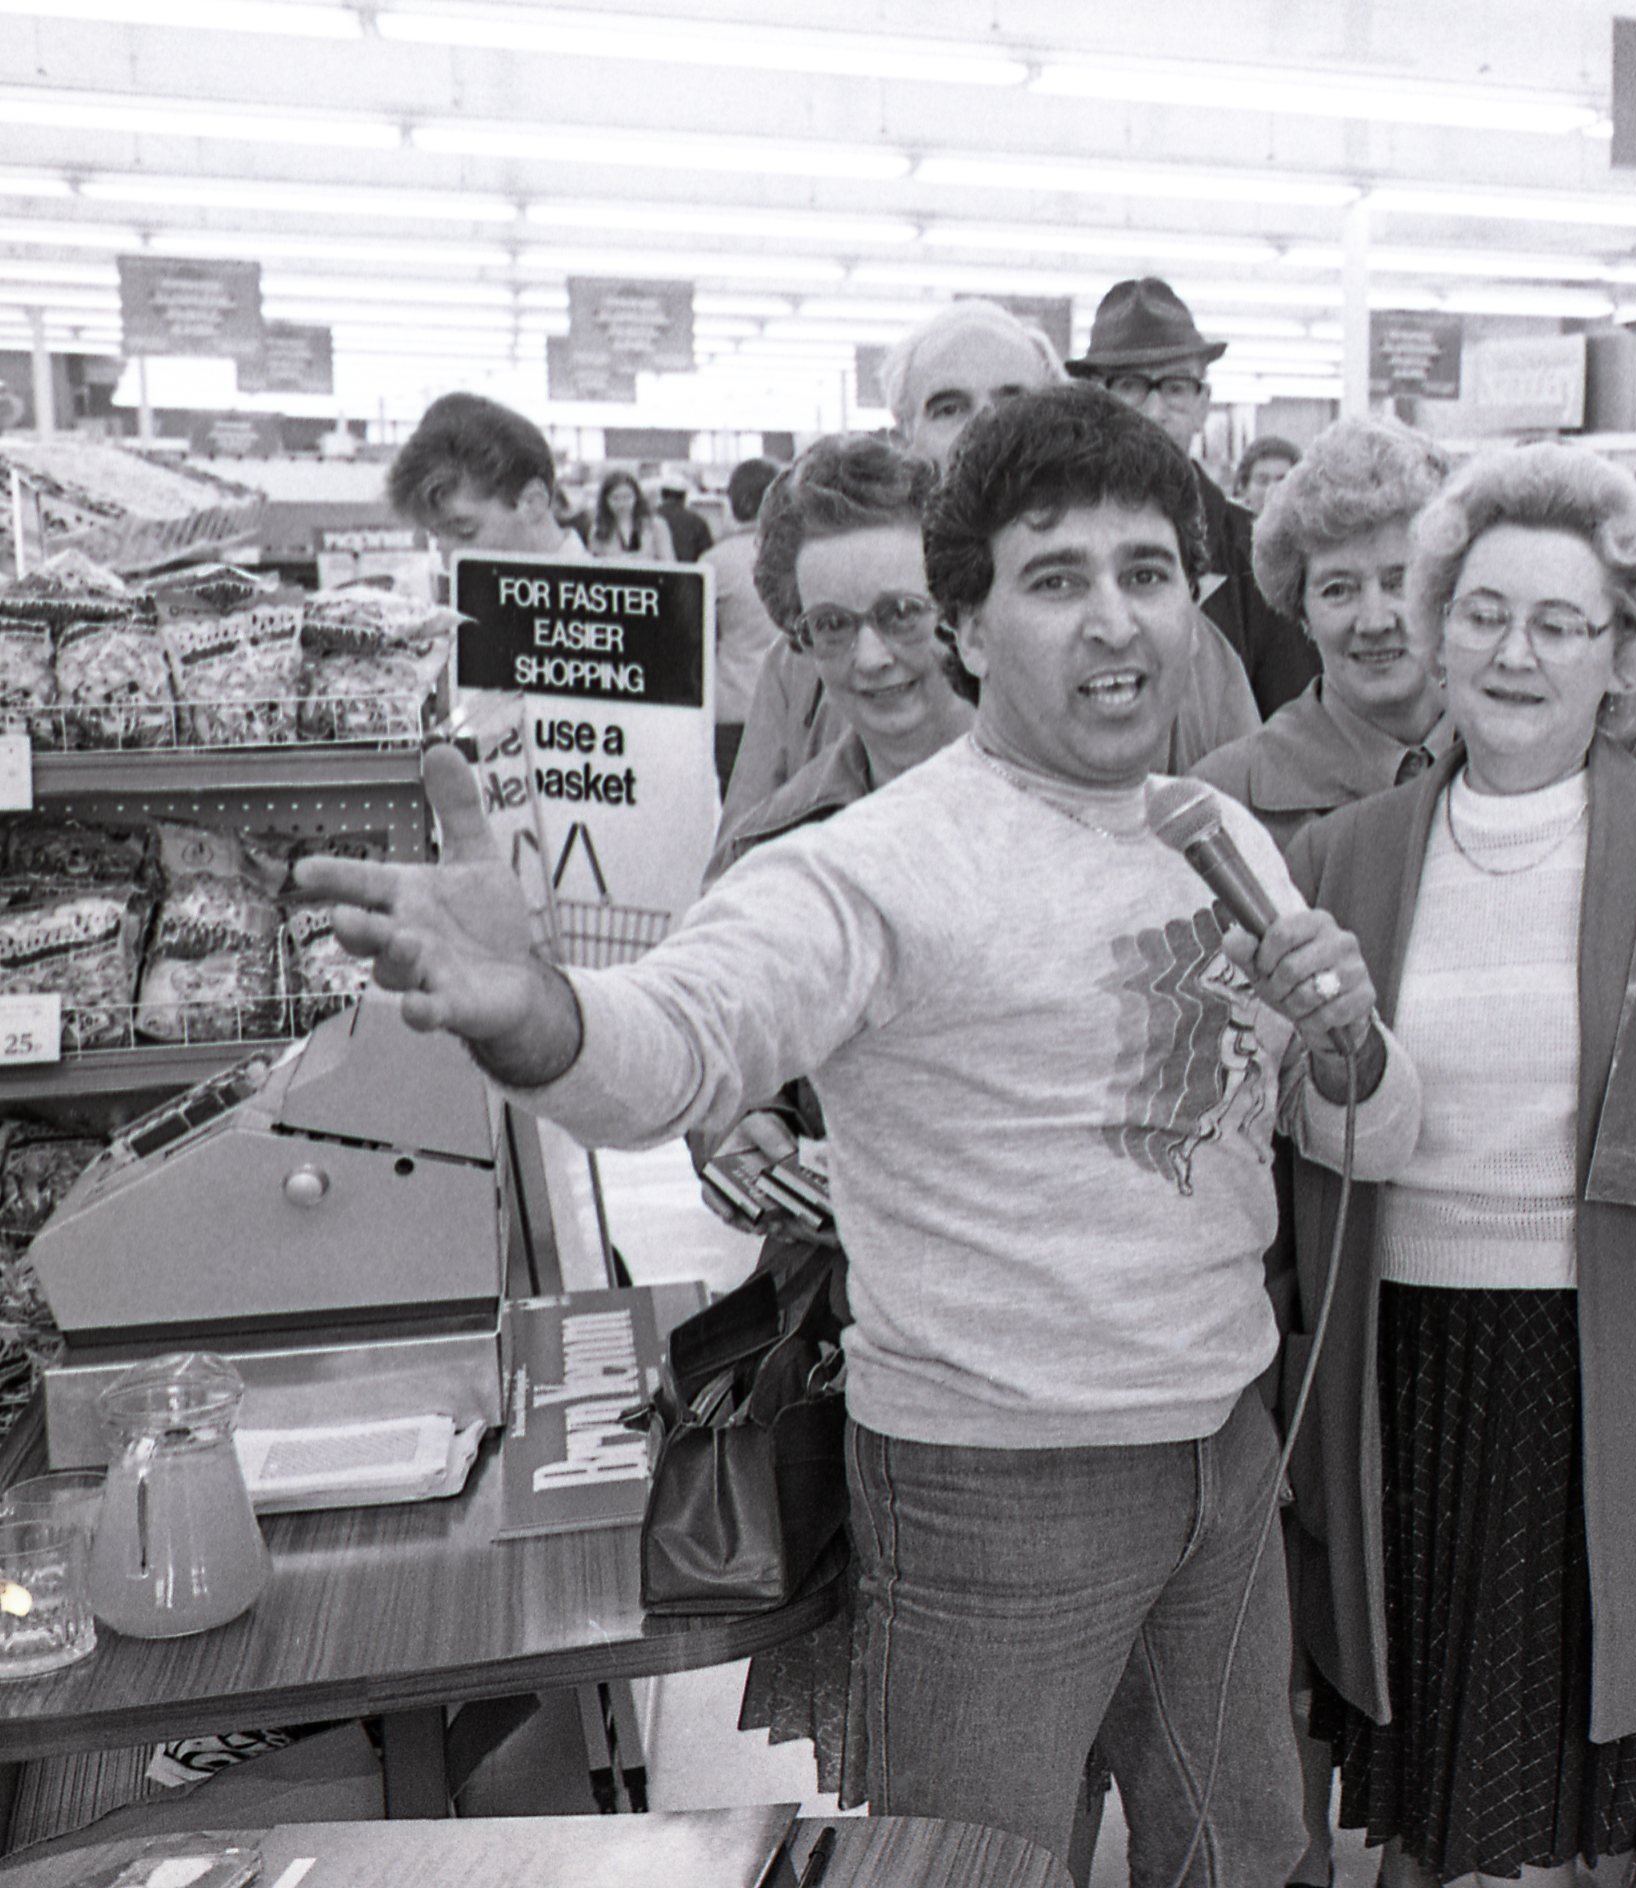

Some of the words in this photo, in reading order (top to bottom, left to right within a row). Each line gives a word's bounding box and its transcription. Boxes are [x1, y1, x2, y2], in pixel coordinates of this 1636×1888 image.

[500, 577, 550, 609] FOR
[559, 582, 659, 616] FASTER
[534, 619, 624, 652] EASIER
[515, 656, 645, 692] SHOPPING
[535, 719, 595, 751] use
[603, 725, 625, 756] a
